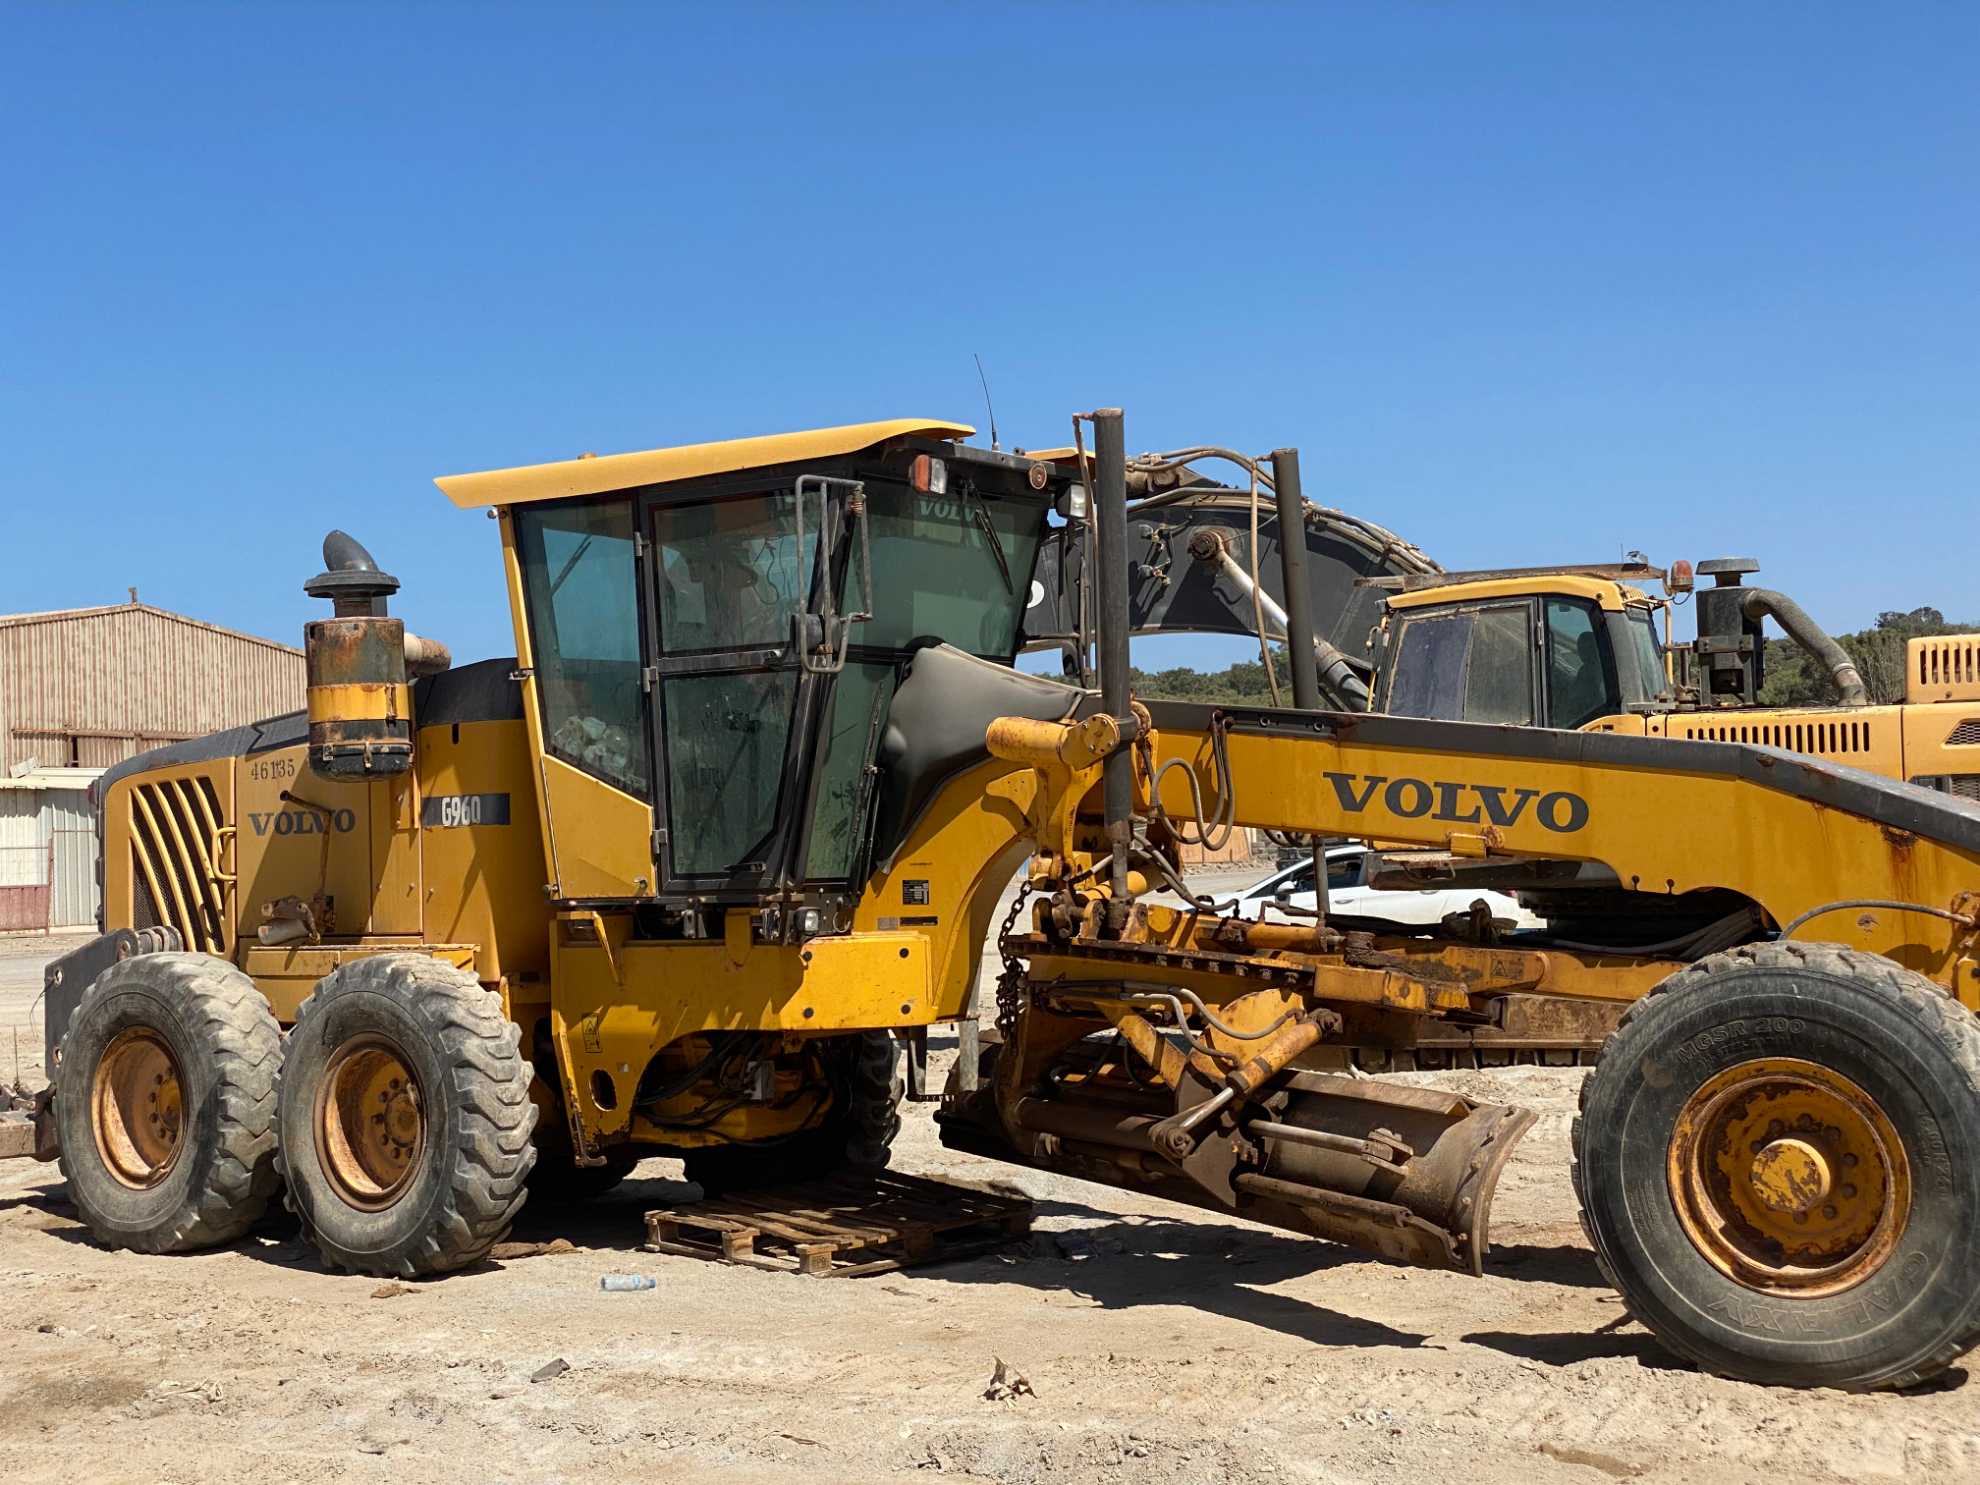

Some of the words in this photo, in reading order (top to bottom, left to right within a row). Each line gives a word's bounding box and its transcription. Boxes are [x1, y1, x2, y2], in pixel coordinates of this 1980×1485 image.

[919, 500, 993, 522] VOLV
[441, 795, 480, 826] G960
[1322, 771, 1590, 833] VOLVO
[1755, 1016, 1806, 1034] 200
